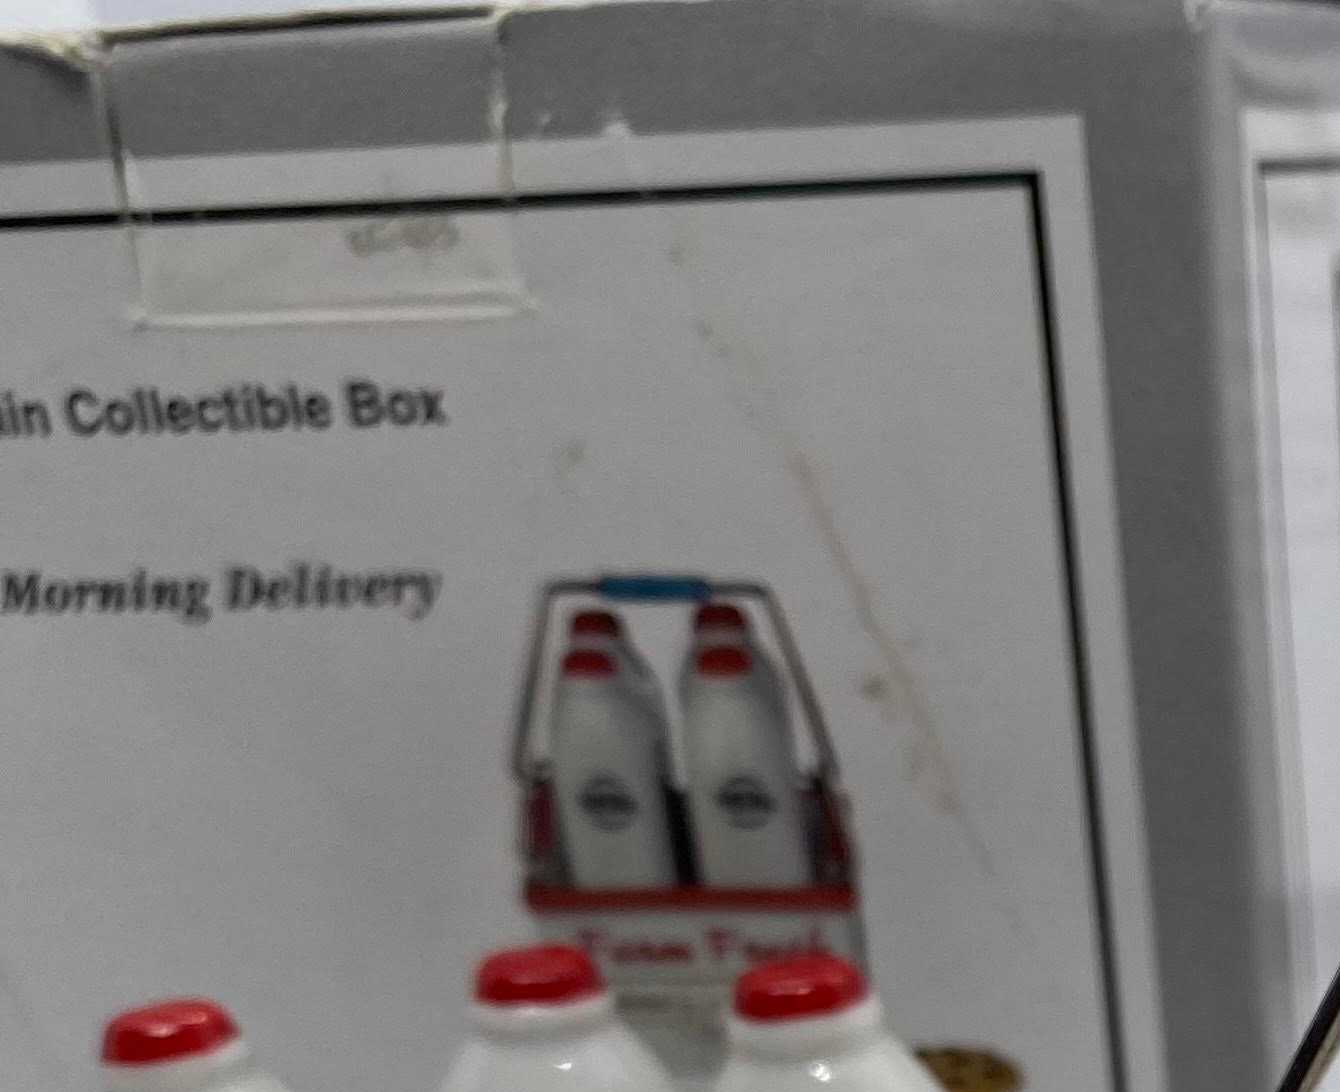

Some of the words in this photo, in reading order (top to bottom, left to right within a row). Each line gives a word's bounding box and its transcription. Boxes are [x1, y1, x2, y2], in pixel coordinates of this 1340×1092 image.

[65, 380, 334, 437] Collectible
[346, 376, 448, 430] Box
[2, 565, 212, 626] Morning
[223, 562, 442, 622] Delivery
